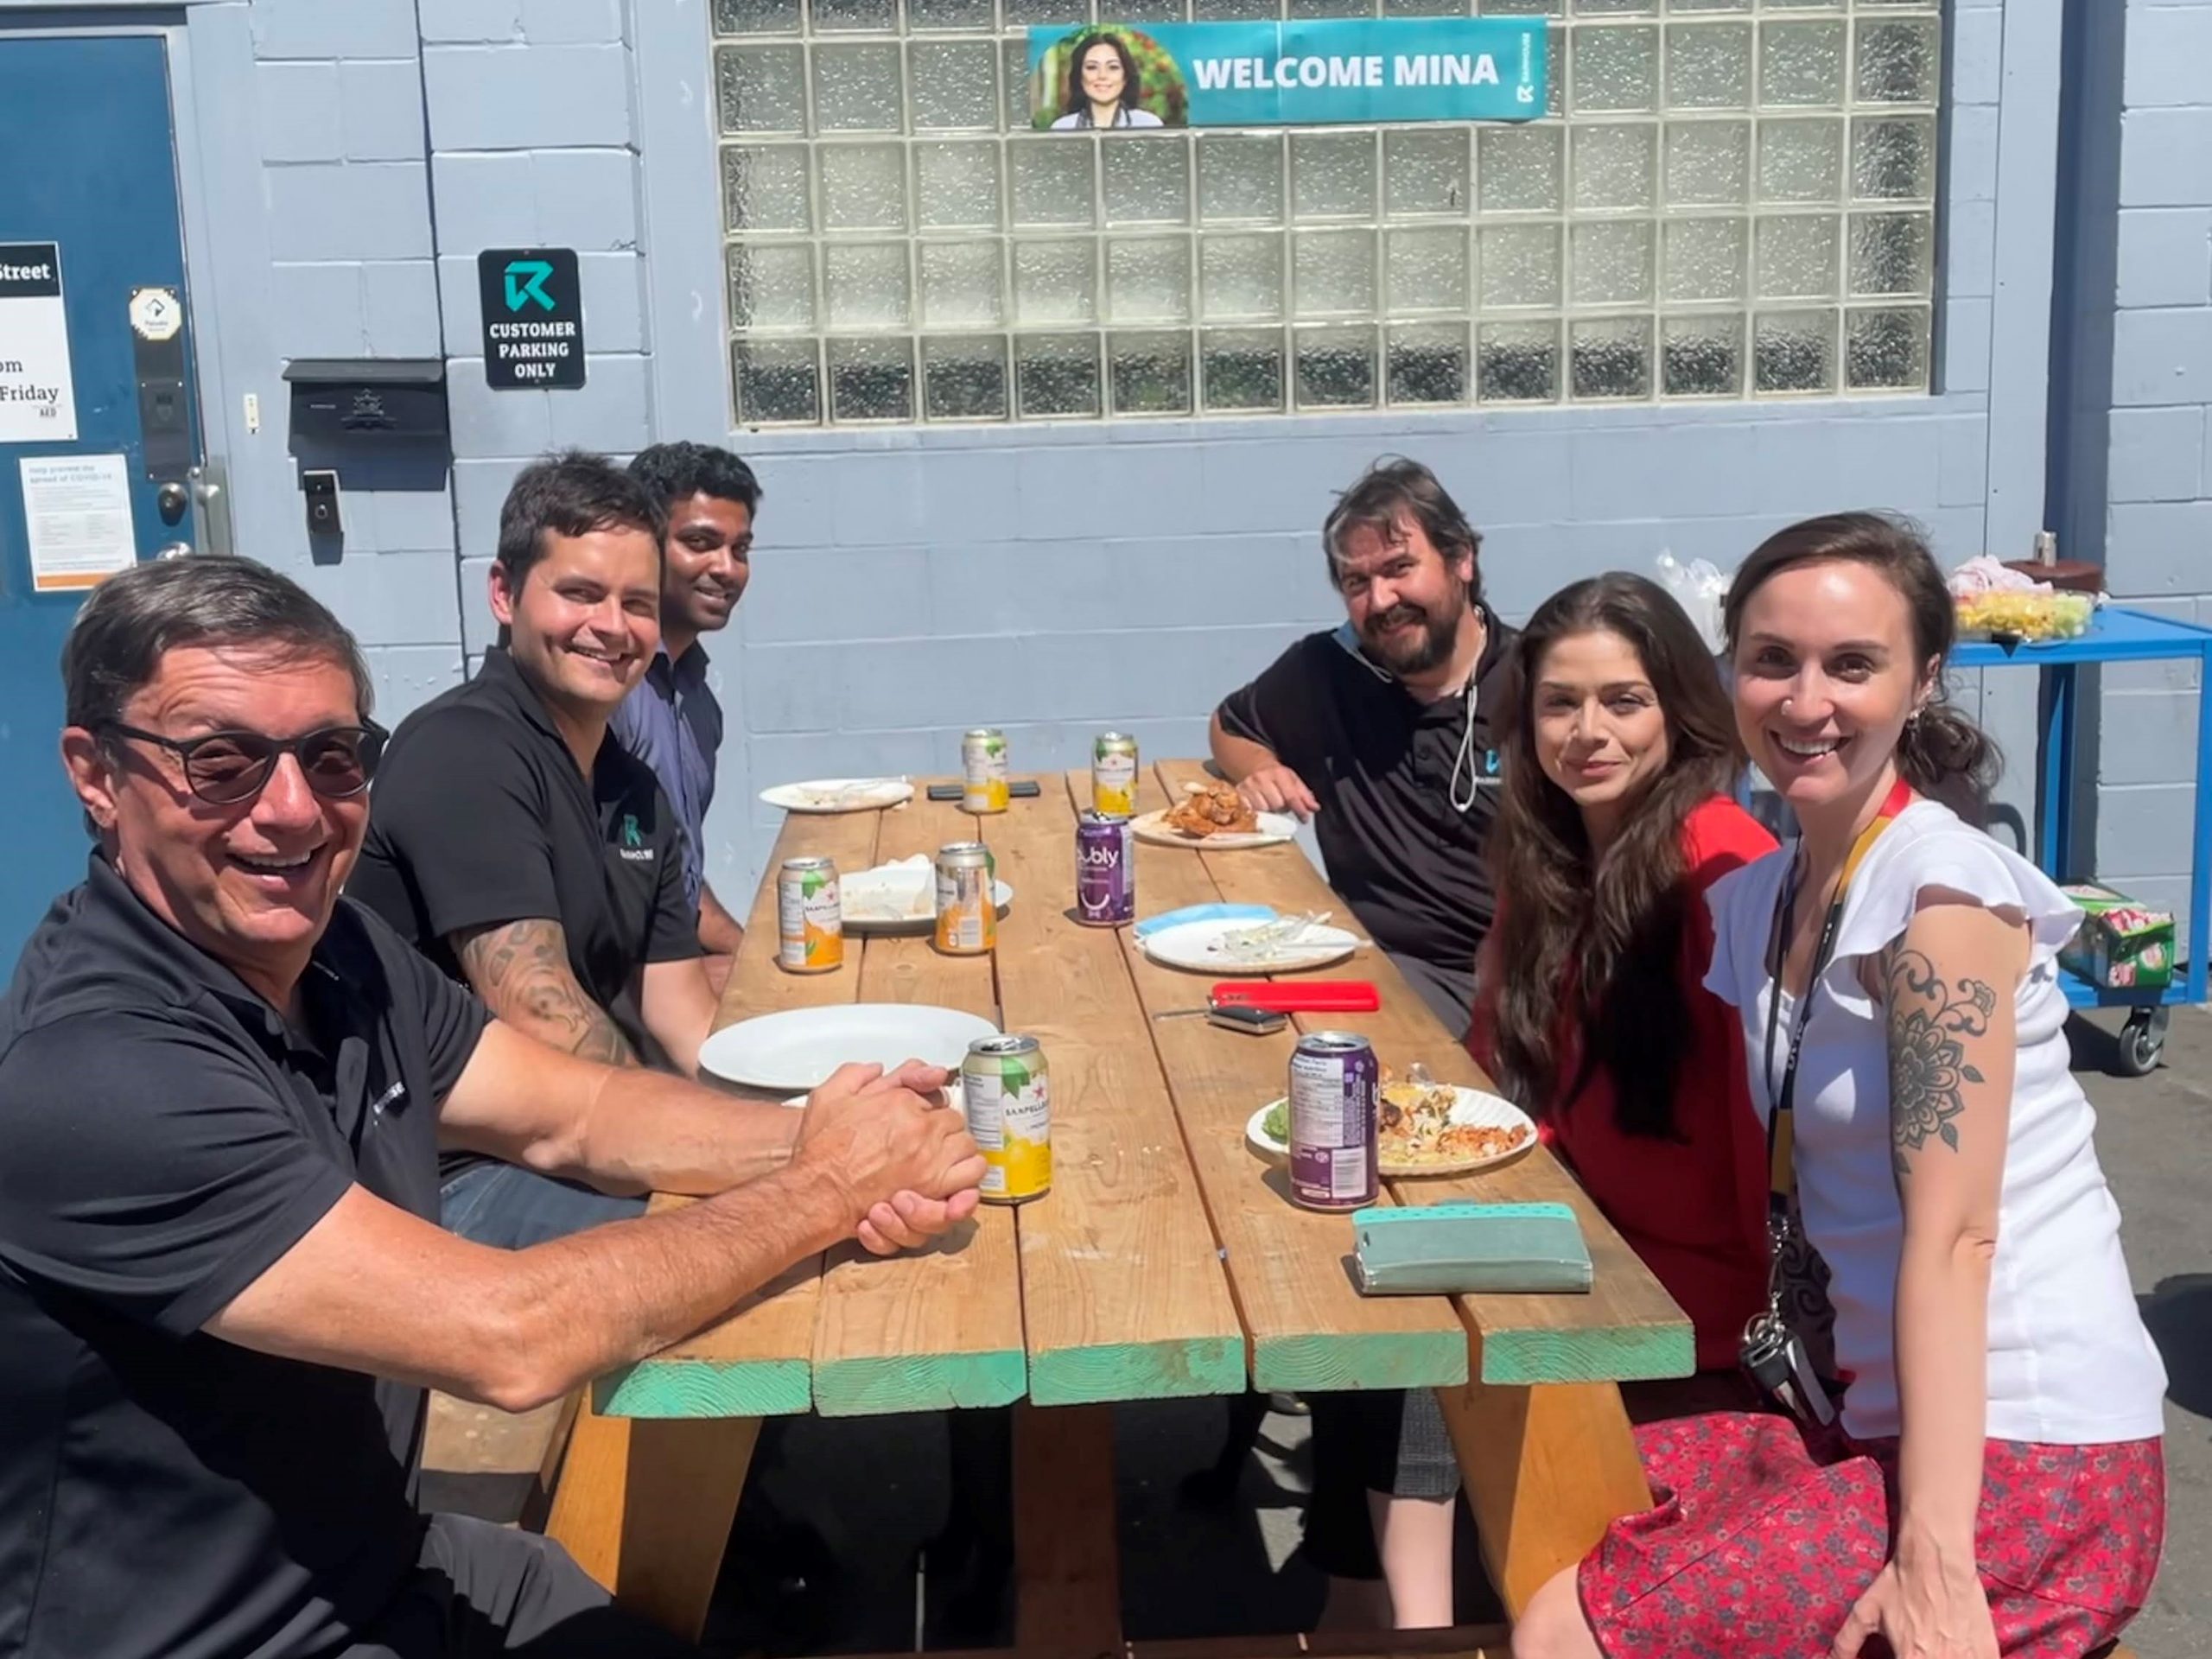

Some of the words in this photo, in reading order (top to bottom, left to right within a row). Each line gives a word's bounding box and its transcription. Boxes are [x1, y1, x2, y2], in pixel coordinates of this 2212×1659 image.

[1193, 56, 1382, 90] WELCOME
[1394, 54, 1500, 86] MINA
[489, 321, 575, 338] CUSTOMER
[499, 342, 569, 359] PARKING
[514, 362, 556, 378] ONLY
[0, 385, 60, 404] Friday
